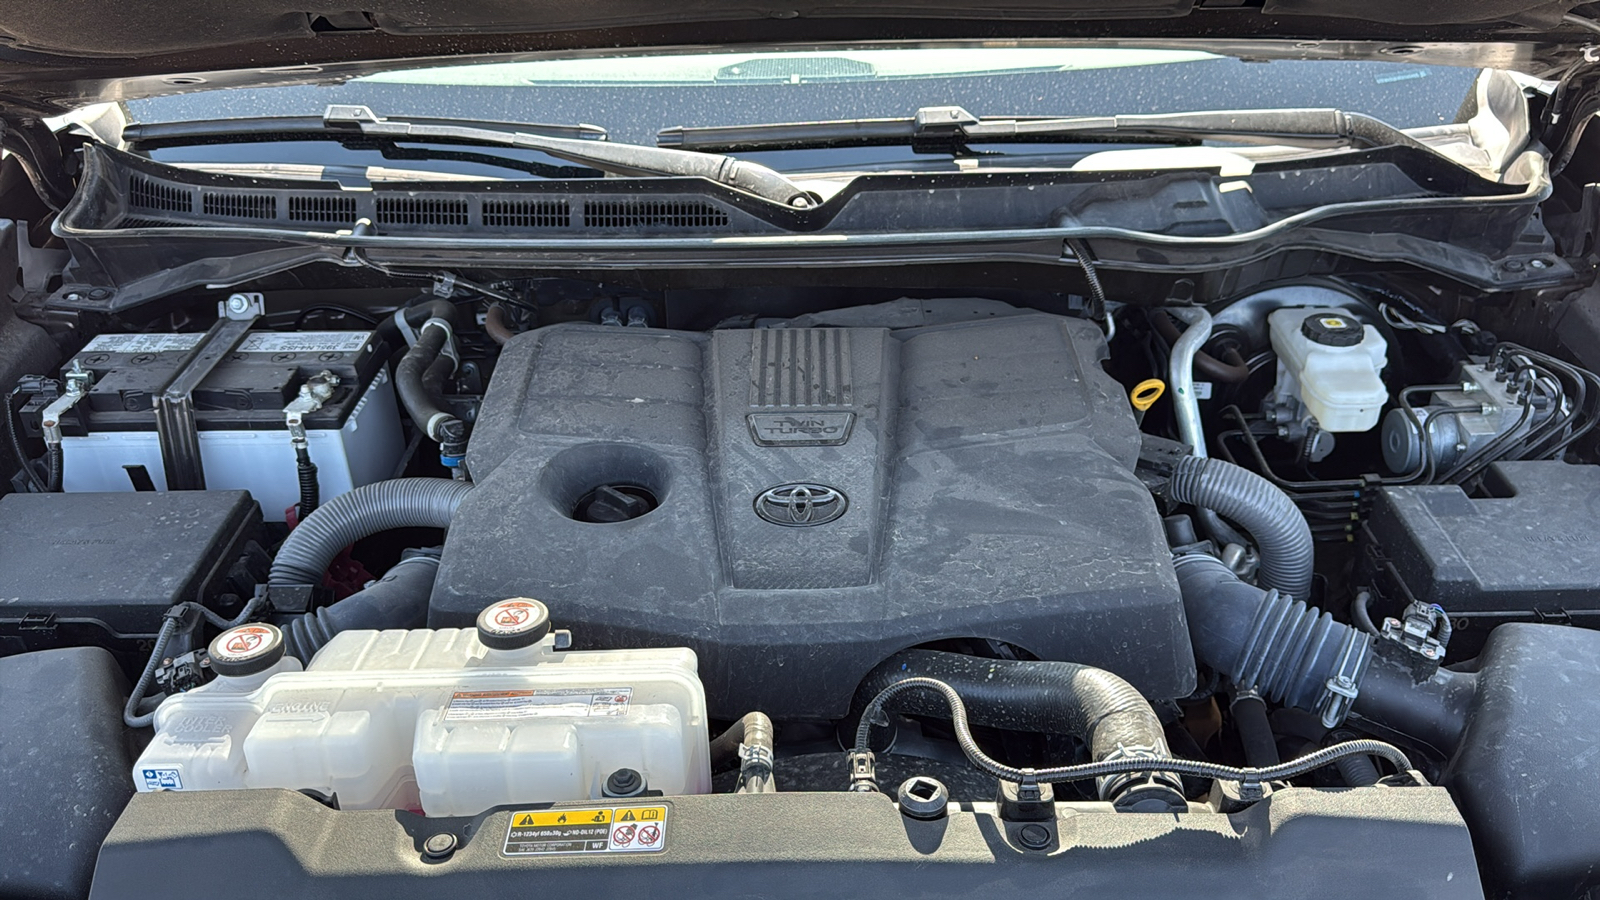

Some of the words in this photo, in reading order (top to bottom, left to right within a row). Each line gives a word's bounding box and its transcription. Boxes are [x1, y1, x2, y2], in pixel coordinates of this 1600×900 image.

[270, 701, 331, 713] ENGINE
[180, 716, 226, 726] INTER
[174, 724, 233, 733] COOLER
